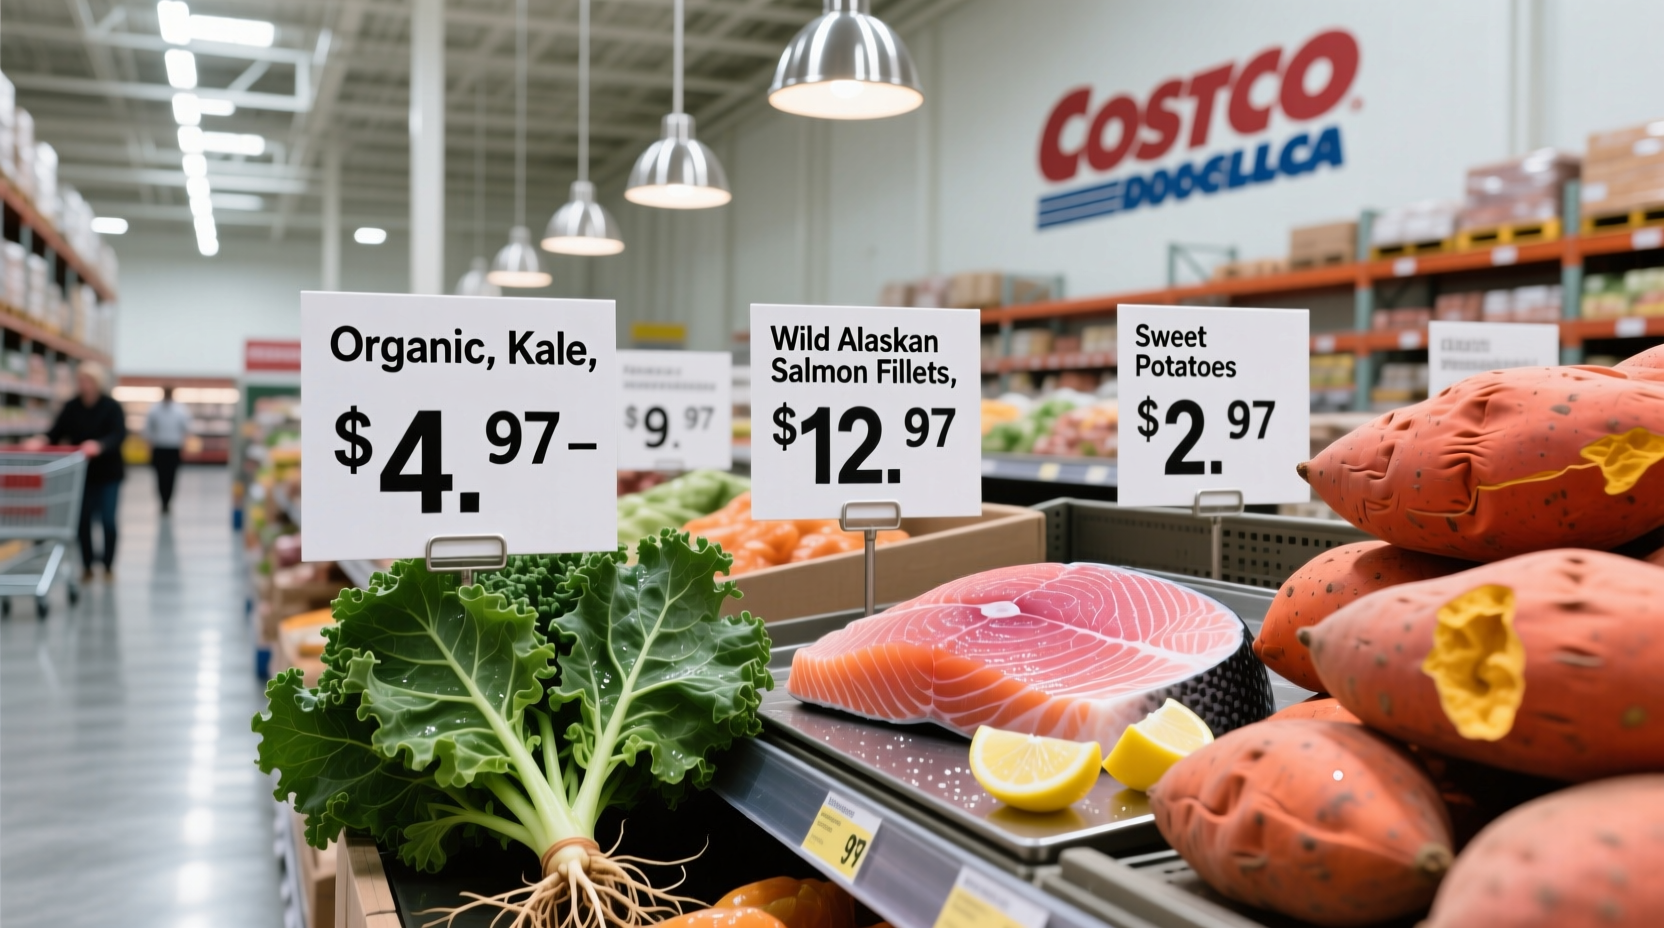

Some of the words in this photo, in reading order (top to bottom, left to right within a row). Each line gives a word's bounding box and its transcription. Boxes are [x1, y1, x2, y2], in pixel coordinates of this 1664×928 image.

[1038, 28, 1361, 183] COSTCO
[330, 325, 496, 373] Organic,
[508, 330, 597, 373] Kale,
[770, 324, 831, 352] Wild
[836, 325, 939, 353] Alaskan
[1135, 323, 1207, 348] Sweet
[771, 356, 868, 384] Salmon
[877, 357, 957, 389] Fillets,
[1135, 353, 1237, 378] Potatoes
